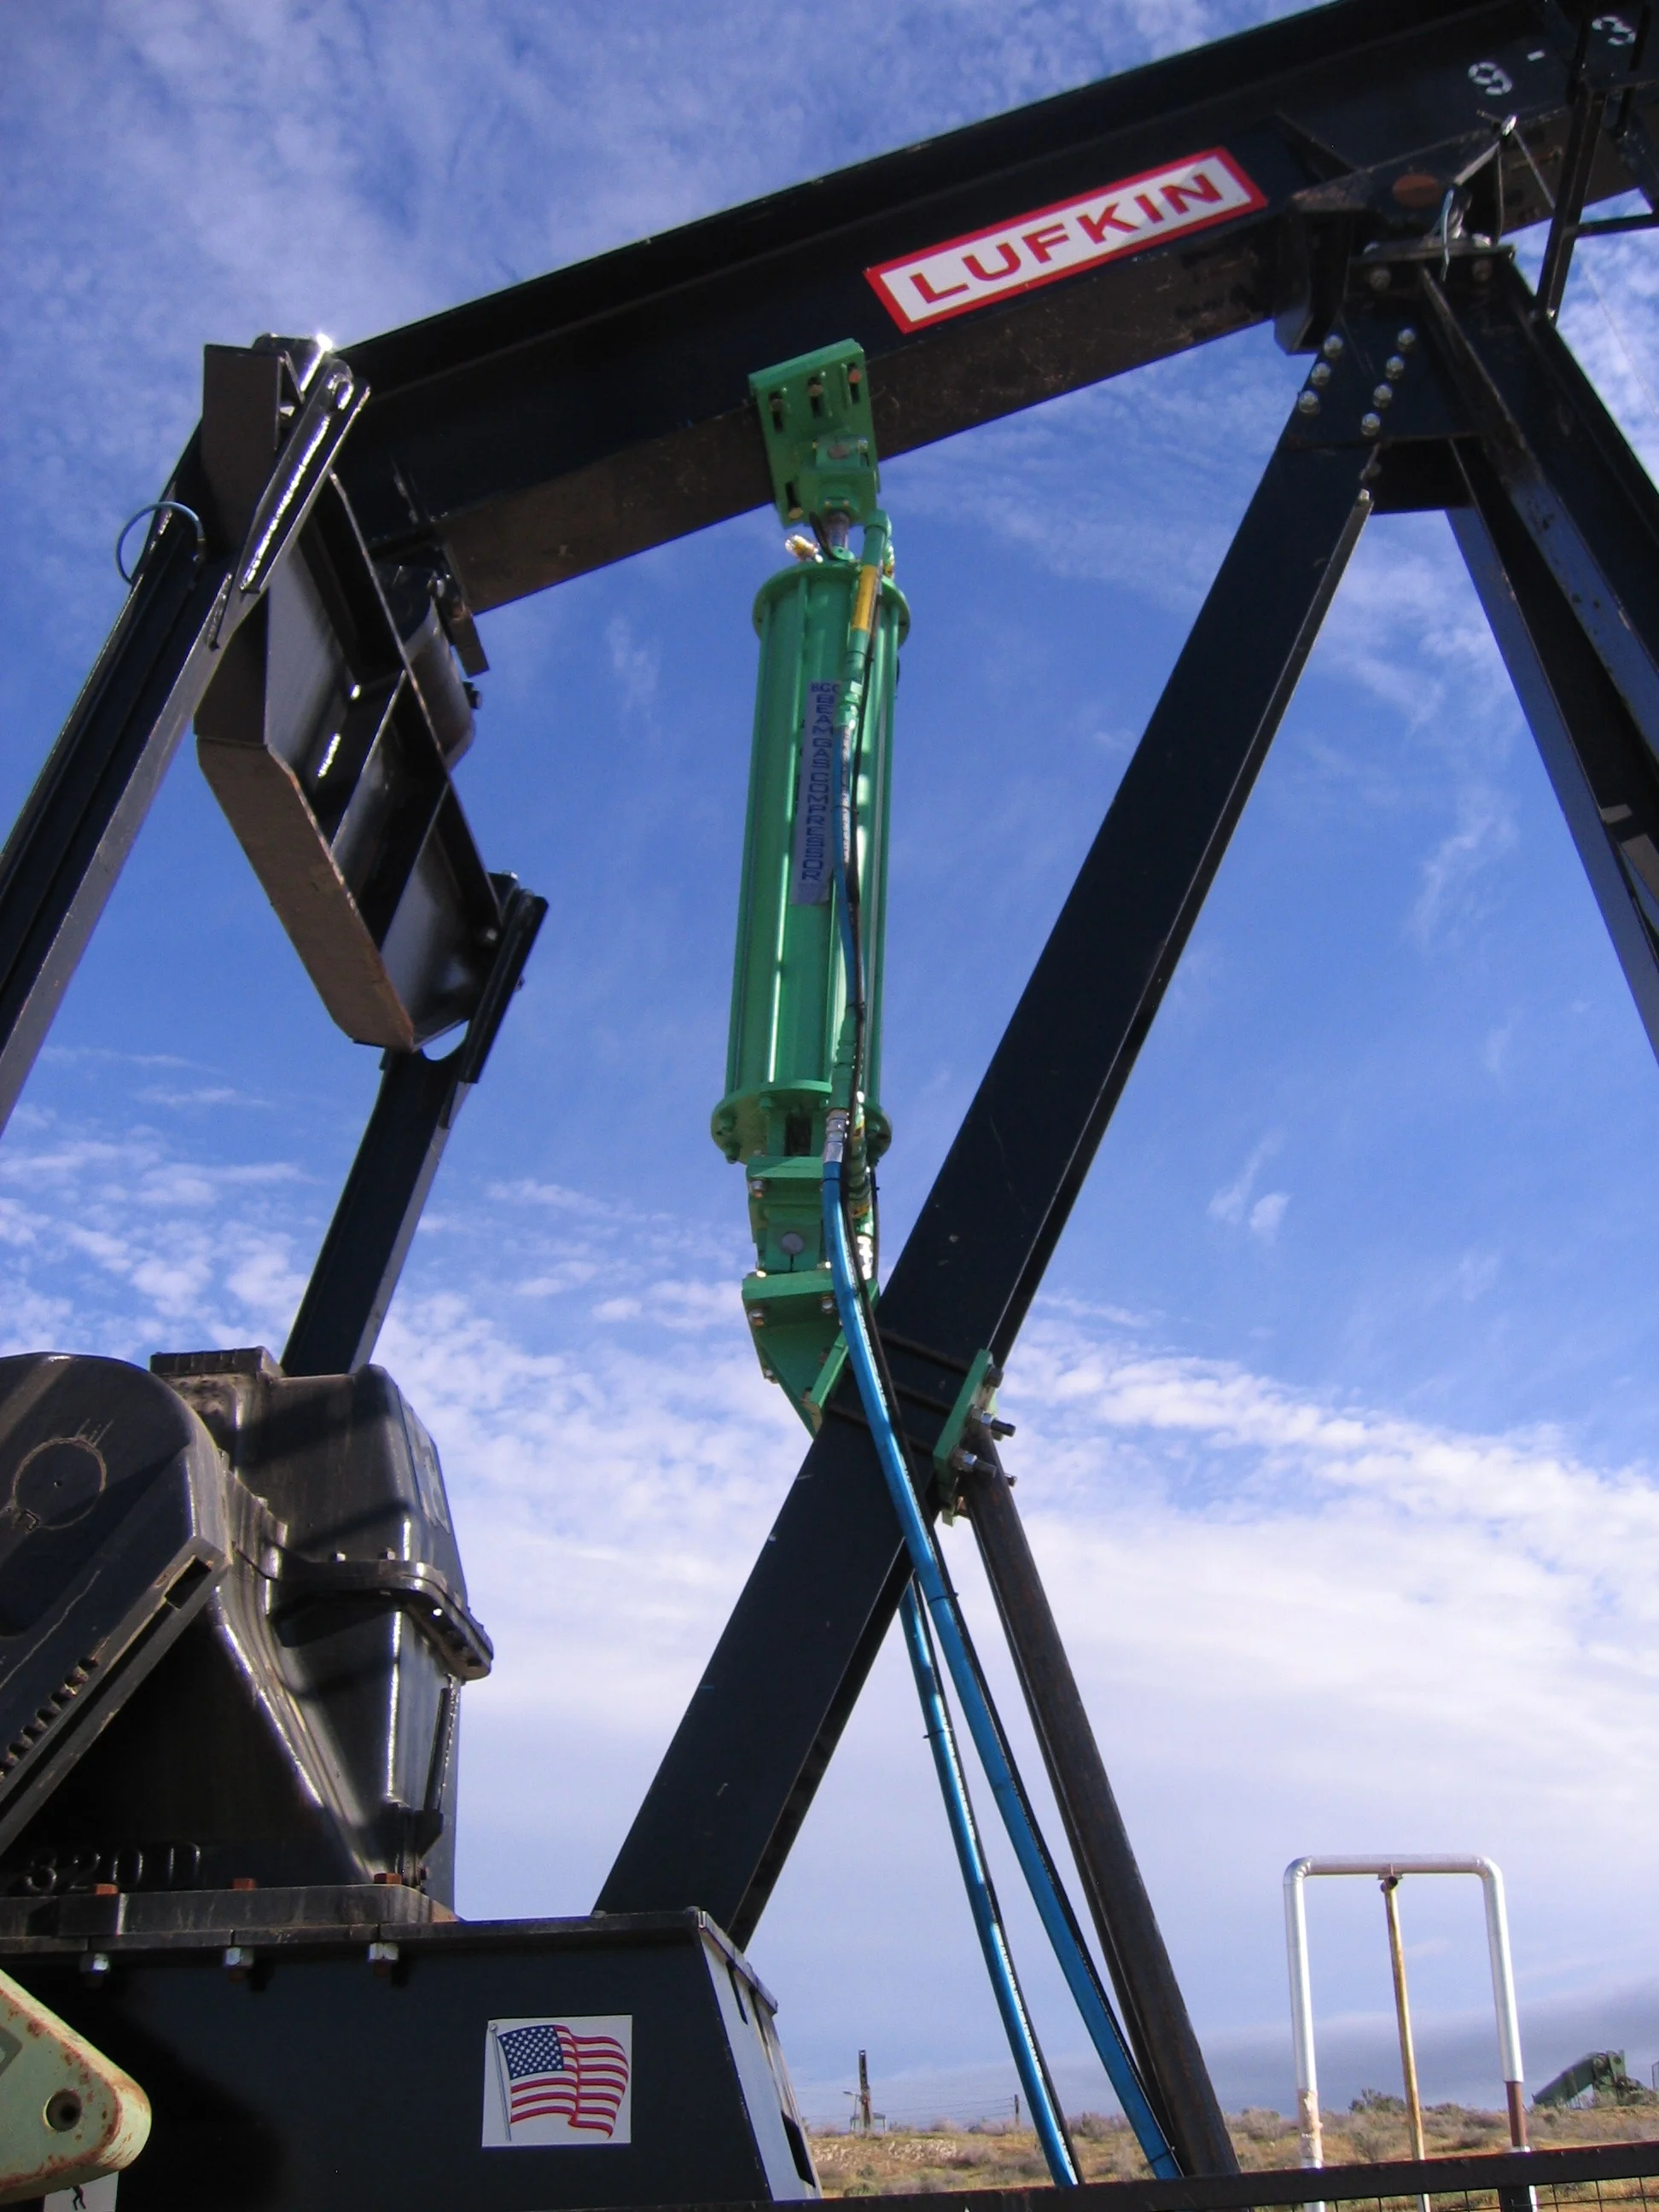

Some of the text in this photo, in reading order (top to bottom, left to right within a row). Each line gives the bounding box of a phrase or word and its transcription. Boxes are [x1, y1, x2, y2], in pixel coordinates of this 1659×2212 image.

[910, 172, 1224, 304] LUFKIN
[812, 693, 835, 735] BEAM
[812, 737, 833, 768] GAS
[802, 771, 830, 882] COMPRESSOR
